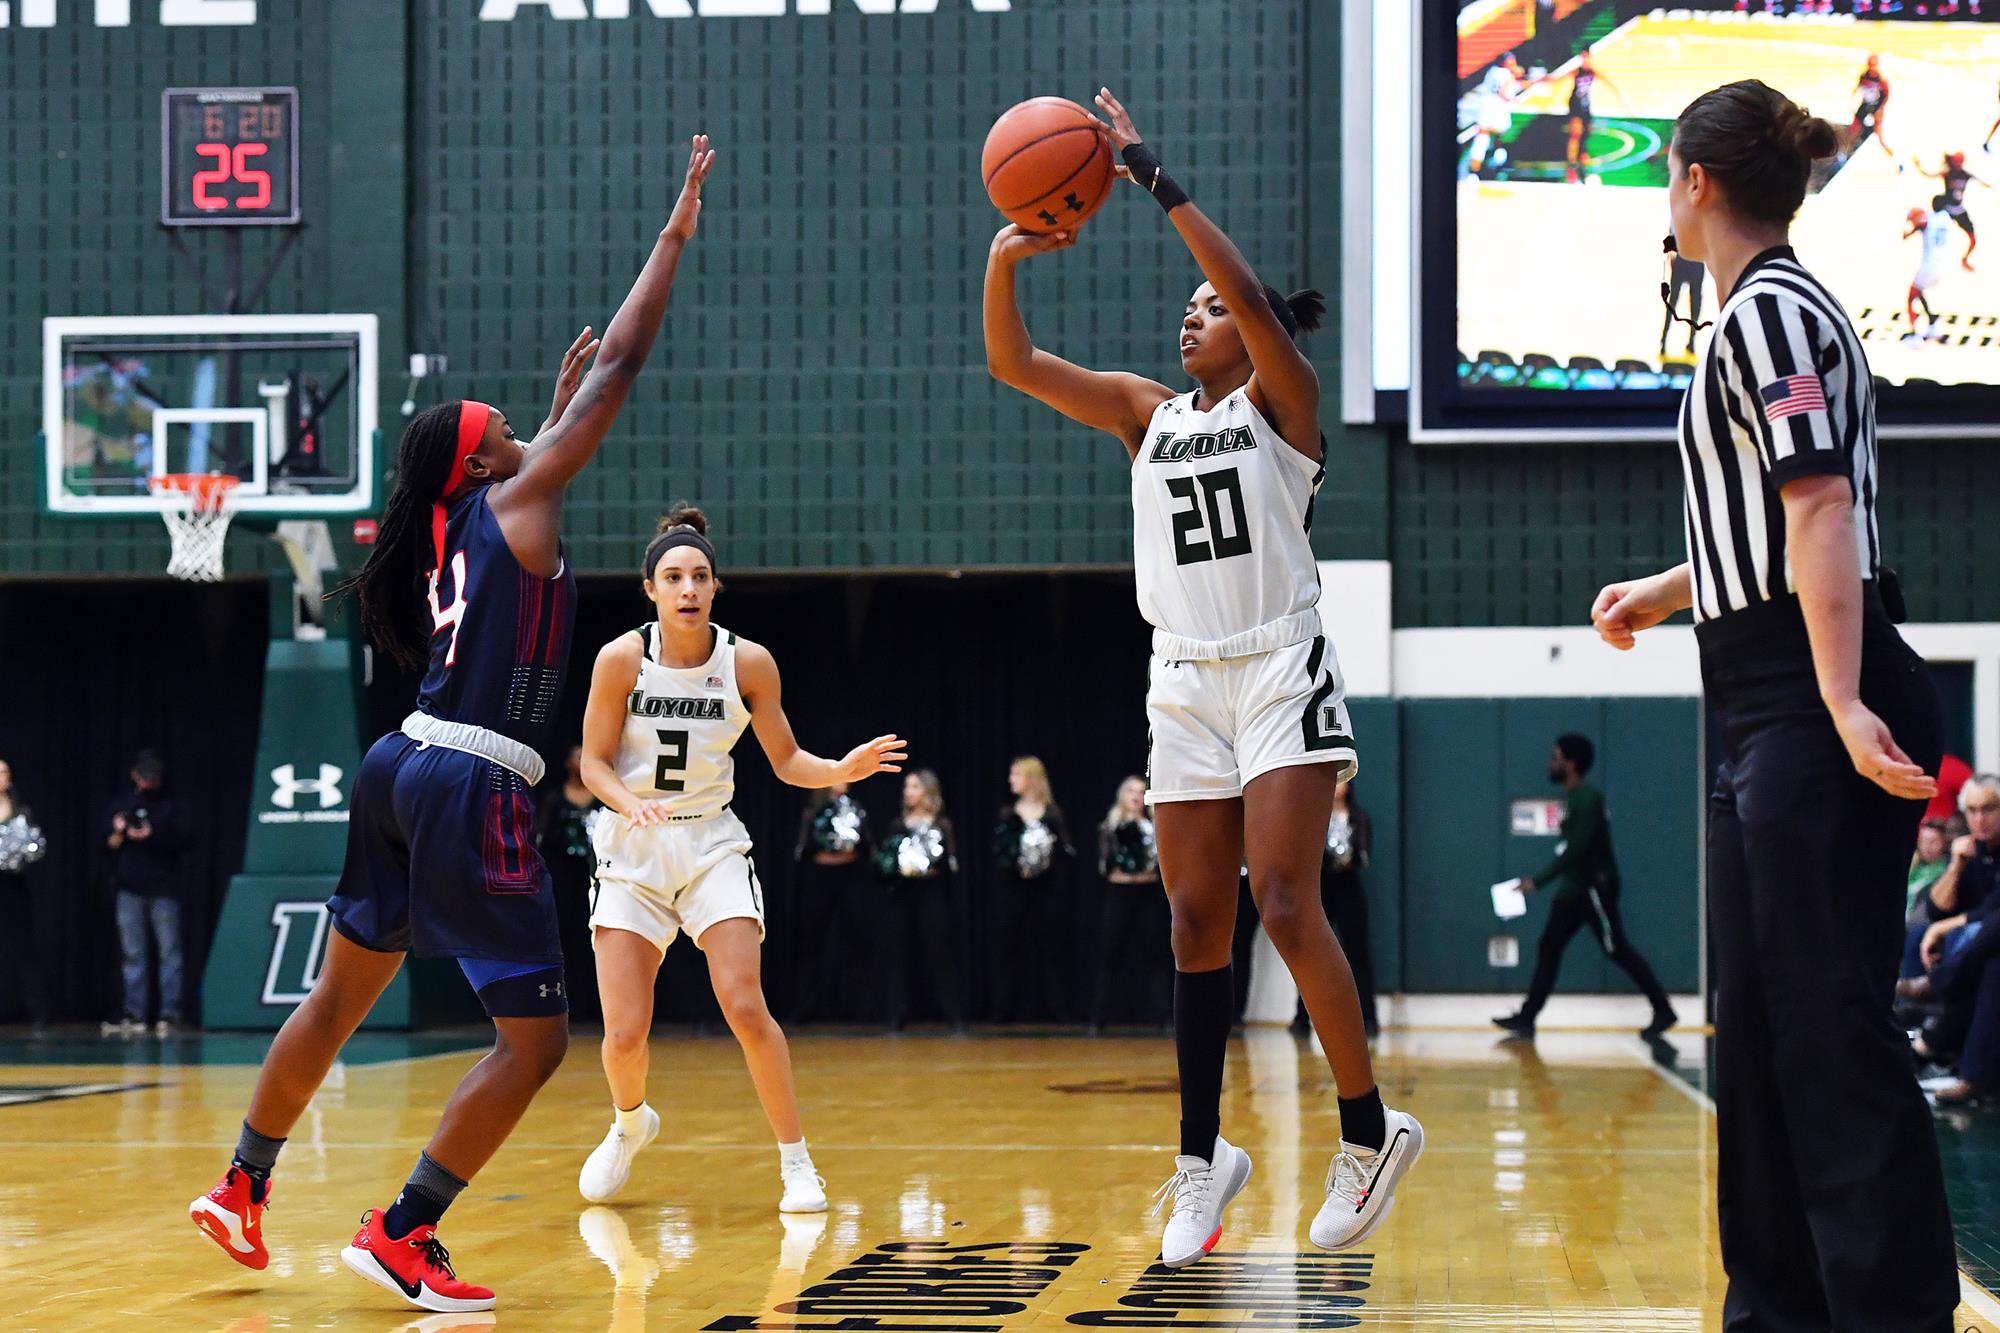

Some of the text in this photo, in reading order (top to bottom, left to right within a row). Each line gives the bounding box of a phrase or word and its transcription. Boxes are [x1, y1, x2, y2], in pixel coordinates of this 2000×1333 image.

[192, 143, 271, 209] 25
[1149, 424, 1258, 463] LOOLA
[1165, 466, 1252, 565] 20
[425, 549, 468, 669] 4
[629, 689, 725, 720] LOYOLA
[1323, 706, 1343, 731] L
[654, 728, 689, 791] 2
[699, 1241, 1092, 1333] FORBES
